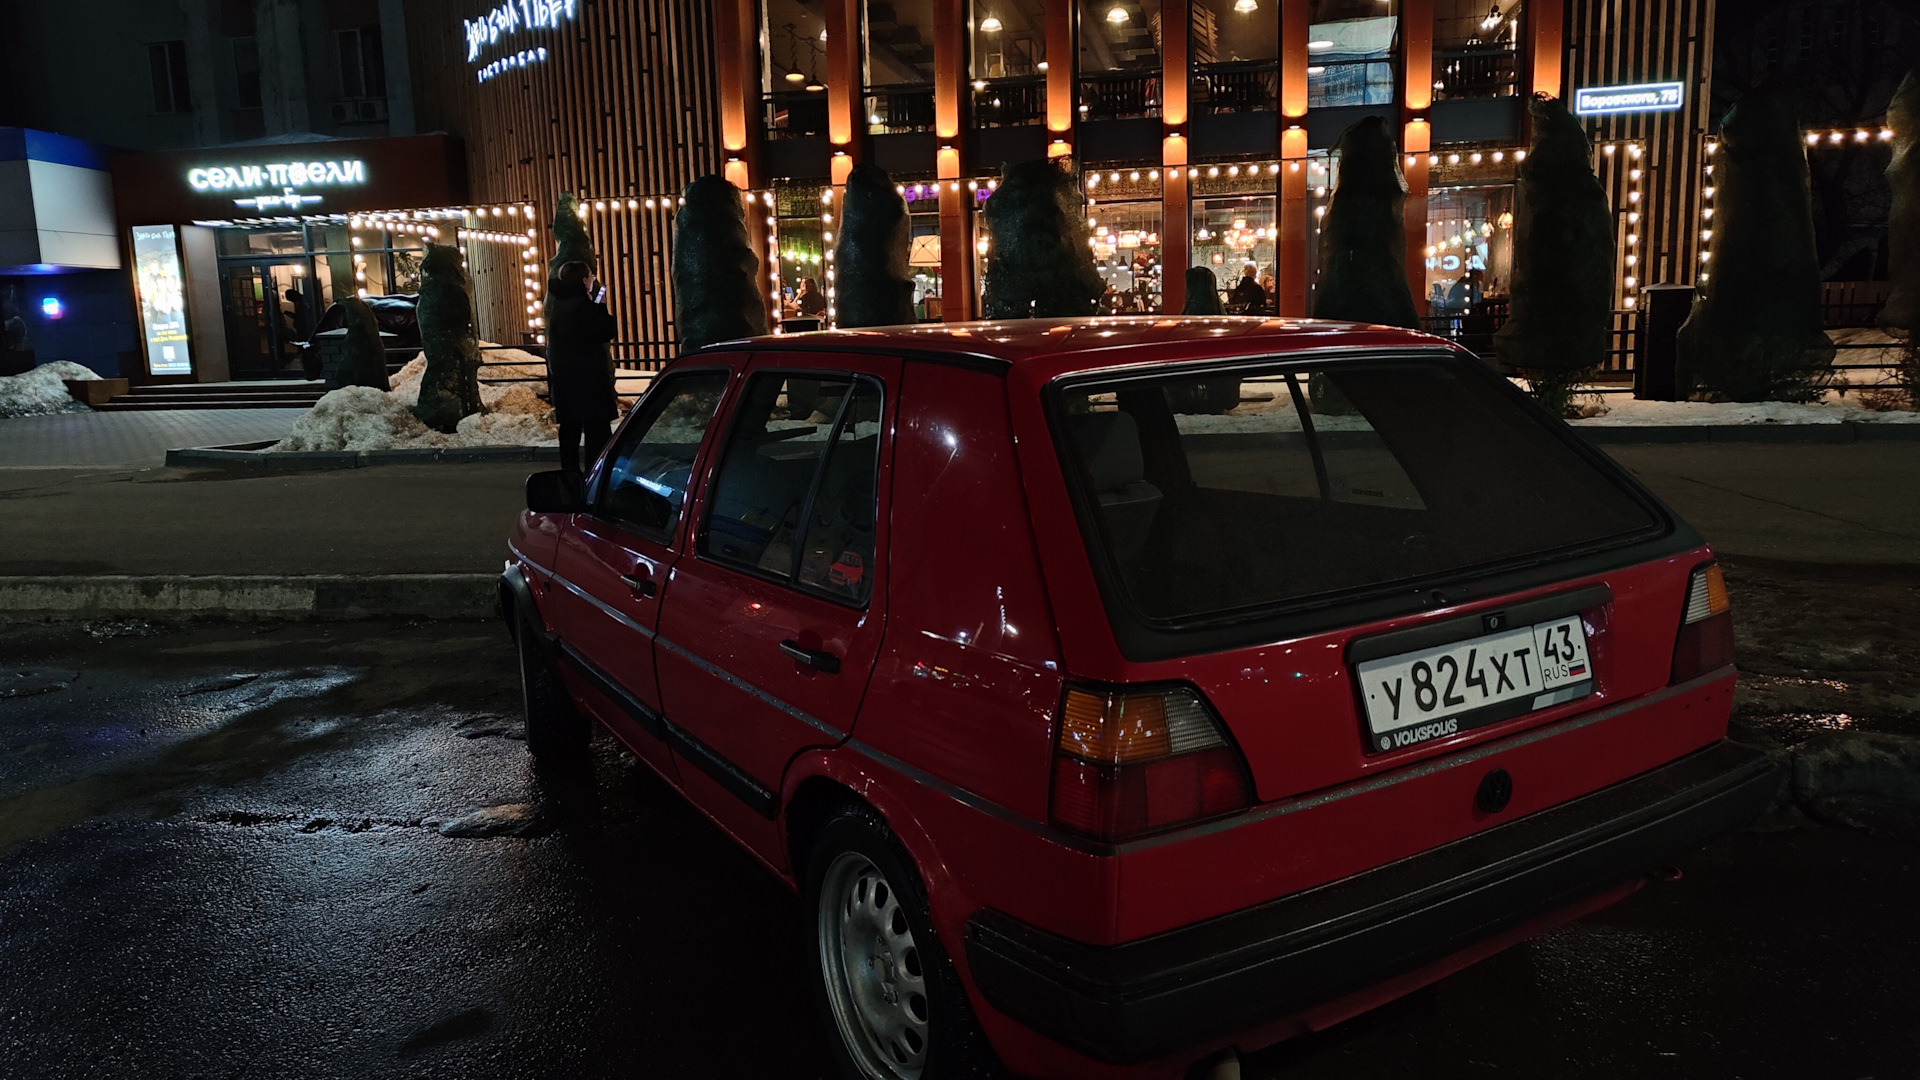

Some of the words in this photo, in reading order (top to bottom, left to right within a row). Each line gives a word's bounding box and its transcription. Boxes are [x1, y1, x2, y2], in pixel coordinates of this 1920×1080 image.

[1382, 648, 1531, 720] У824ХТ
[1544, 624, 1575, 664] 43
[1544, 665, 1569, 682] RUS
[1393, 718, 1458, 747] VOLKSFOLKS
